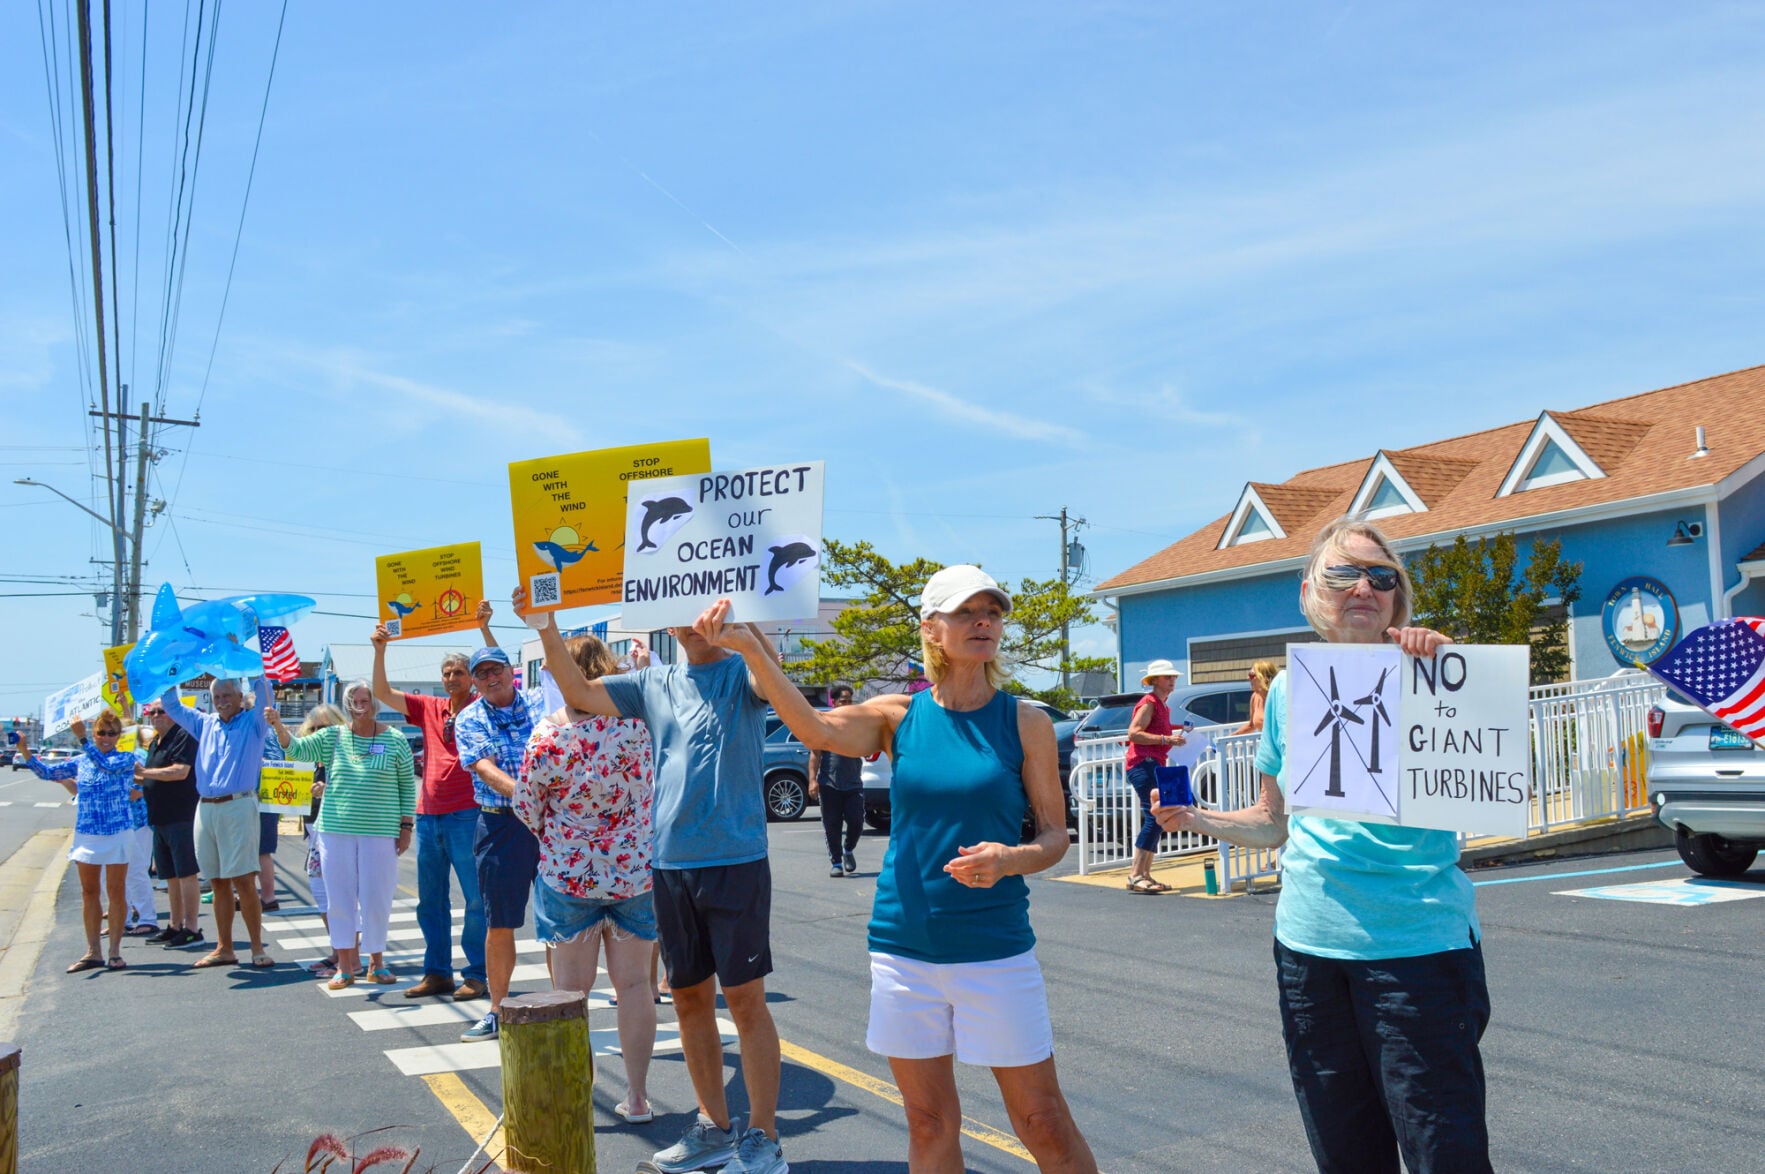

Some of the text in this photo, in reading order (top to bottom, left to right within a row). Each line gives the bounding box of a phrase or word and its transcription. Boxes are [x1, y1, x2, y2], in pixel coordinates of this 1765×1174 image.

[633, 457, 660, 468] STOP
[532, 471, 559, 482] GONE
[619, 468, 674, 481] OFFSHORE
[699, 466, 811, 503] PROTECT
[543, 481, 568, 491] WITH
[552, 492, 571, 502] THE
[560, 502, 587, 512] WIND
[728, 508, 772, 528] our
[678, 534, 753, 563] OCEAN
[432, 559, 461, 567] OFFSHORE
[624, 565, 760, 603] ENVIRONMENT
[1608, 582, 1664, 607] TOWN HALL
[1607, 629, 1671, 661] FENWICK ISLAND
[184, 680, 209, 688] MUSEU
[1413, 652, 1467, 696] NO
[70, 695, 100, 716] ATLANTIC
[1434, 700, 1457, 718] to
[1409, 724, 1510, 757] GIANT
[1407, 768, 1524, 804] TURBINES
